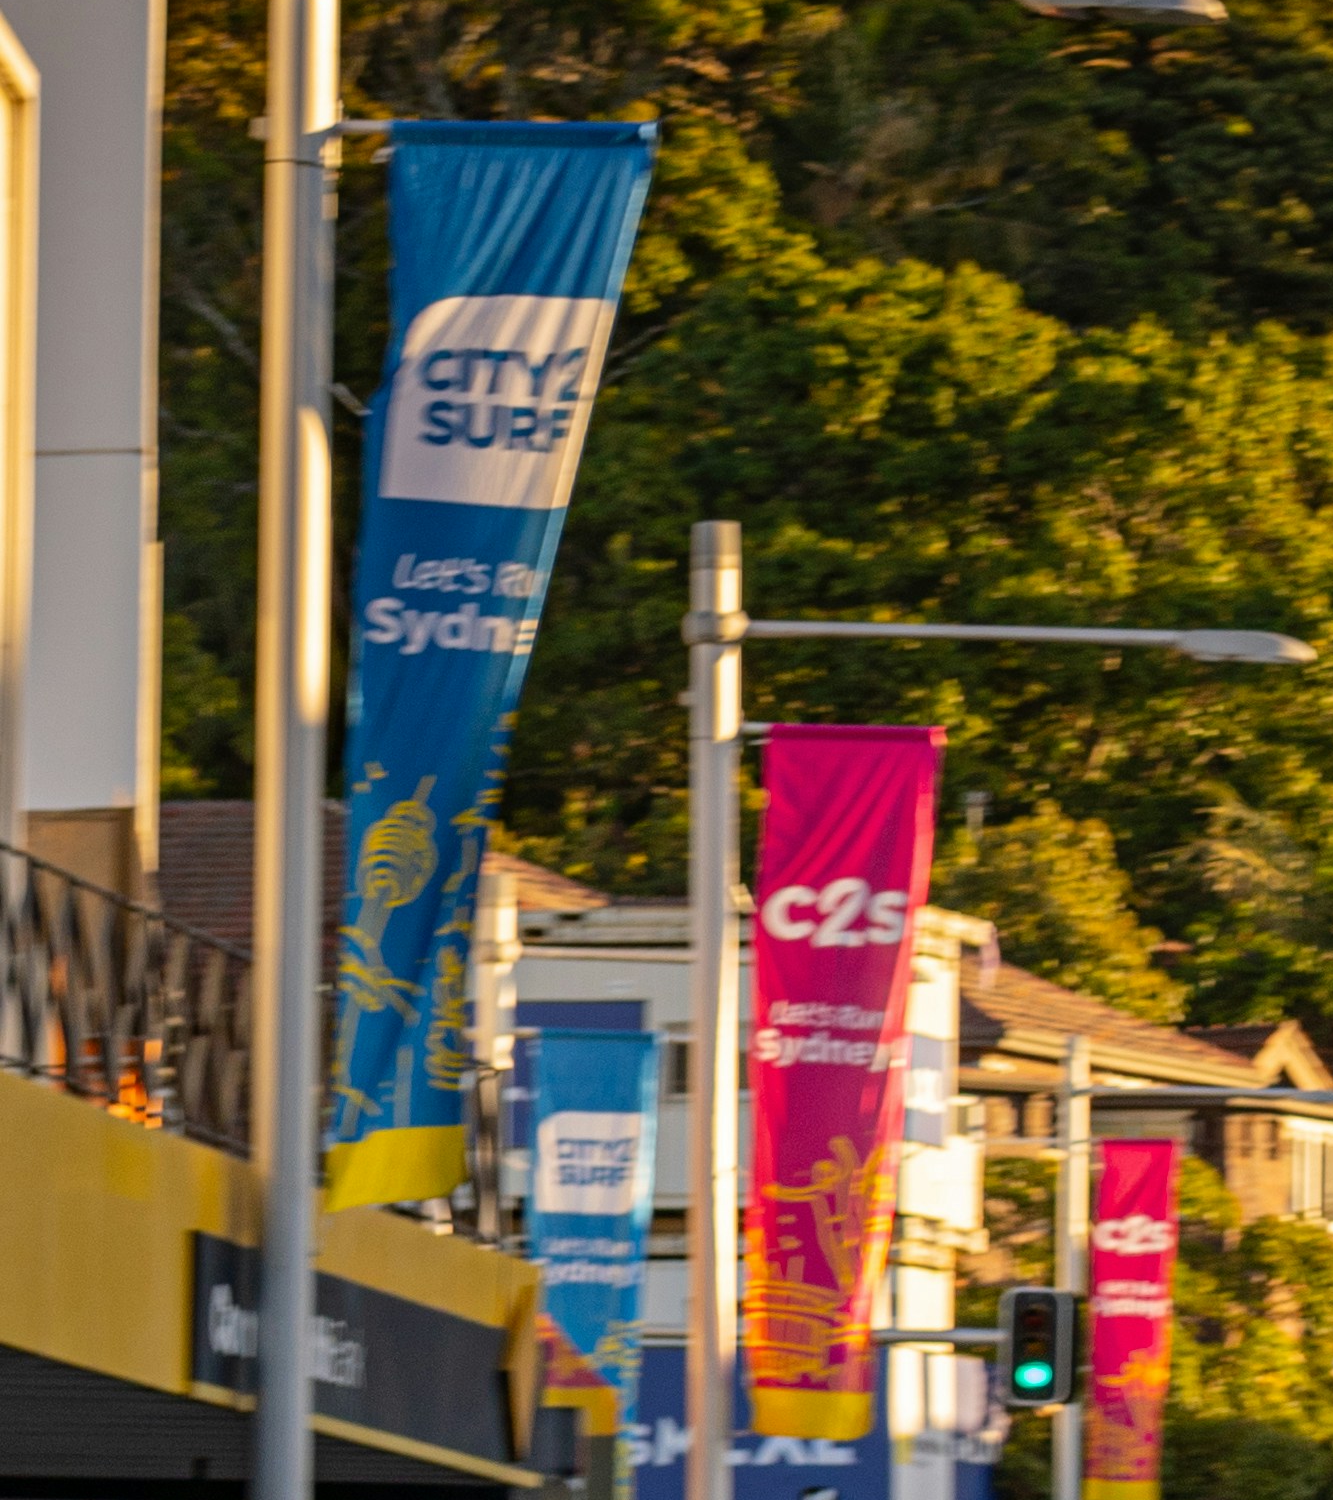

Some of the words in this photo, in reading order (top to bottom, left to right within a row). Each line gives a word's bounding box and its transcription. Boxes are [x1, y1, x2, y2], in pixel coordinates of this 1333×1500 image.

[421, 345, 589, 400] CITY2
[420, 400, 574, 453] SURF
[392, 553, 491, 596] Let's
[760, 876, 908, 948] c2s
